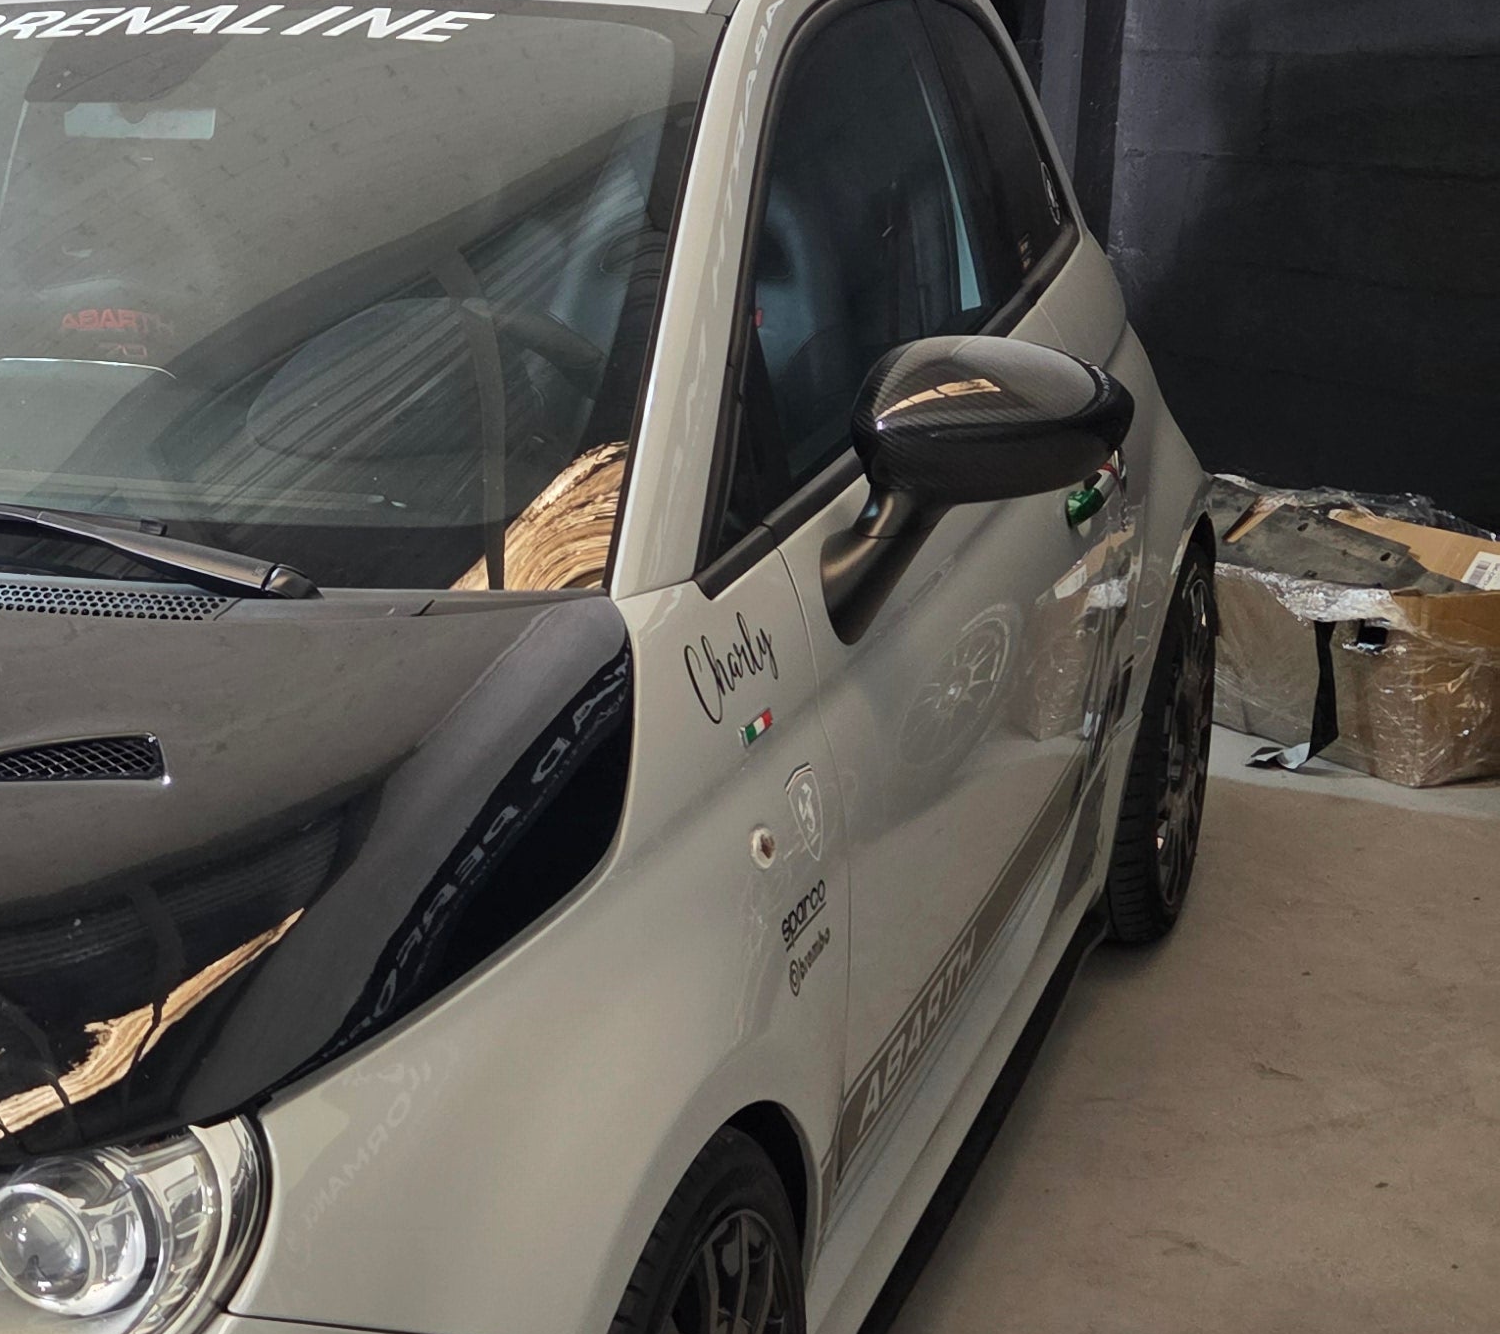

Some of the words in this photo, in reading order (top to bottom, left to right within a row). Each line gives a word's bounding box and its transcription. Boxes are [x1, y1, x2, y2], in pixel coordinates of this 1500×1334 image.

[684, 611, 779, 725] Charly
[782, 879, 827, 950] sparco
[857, 926, 978, 1138] ABARTH
